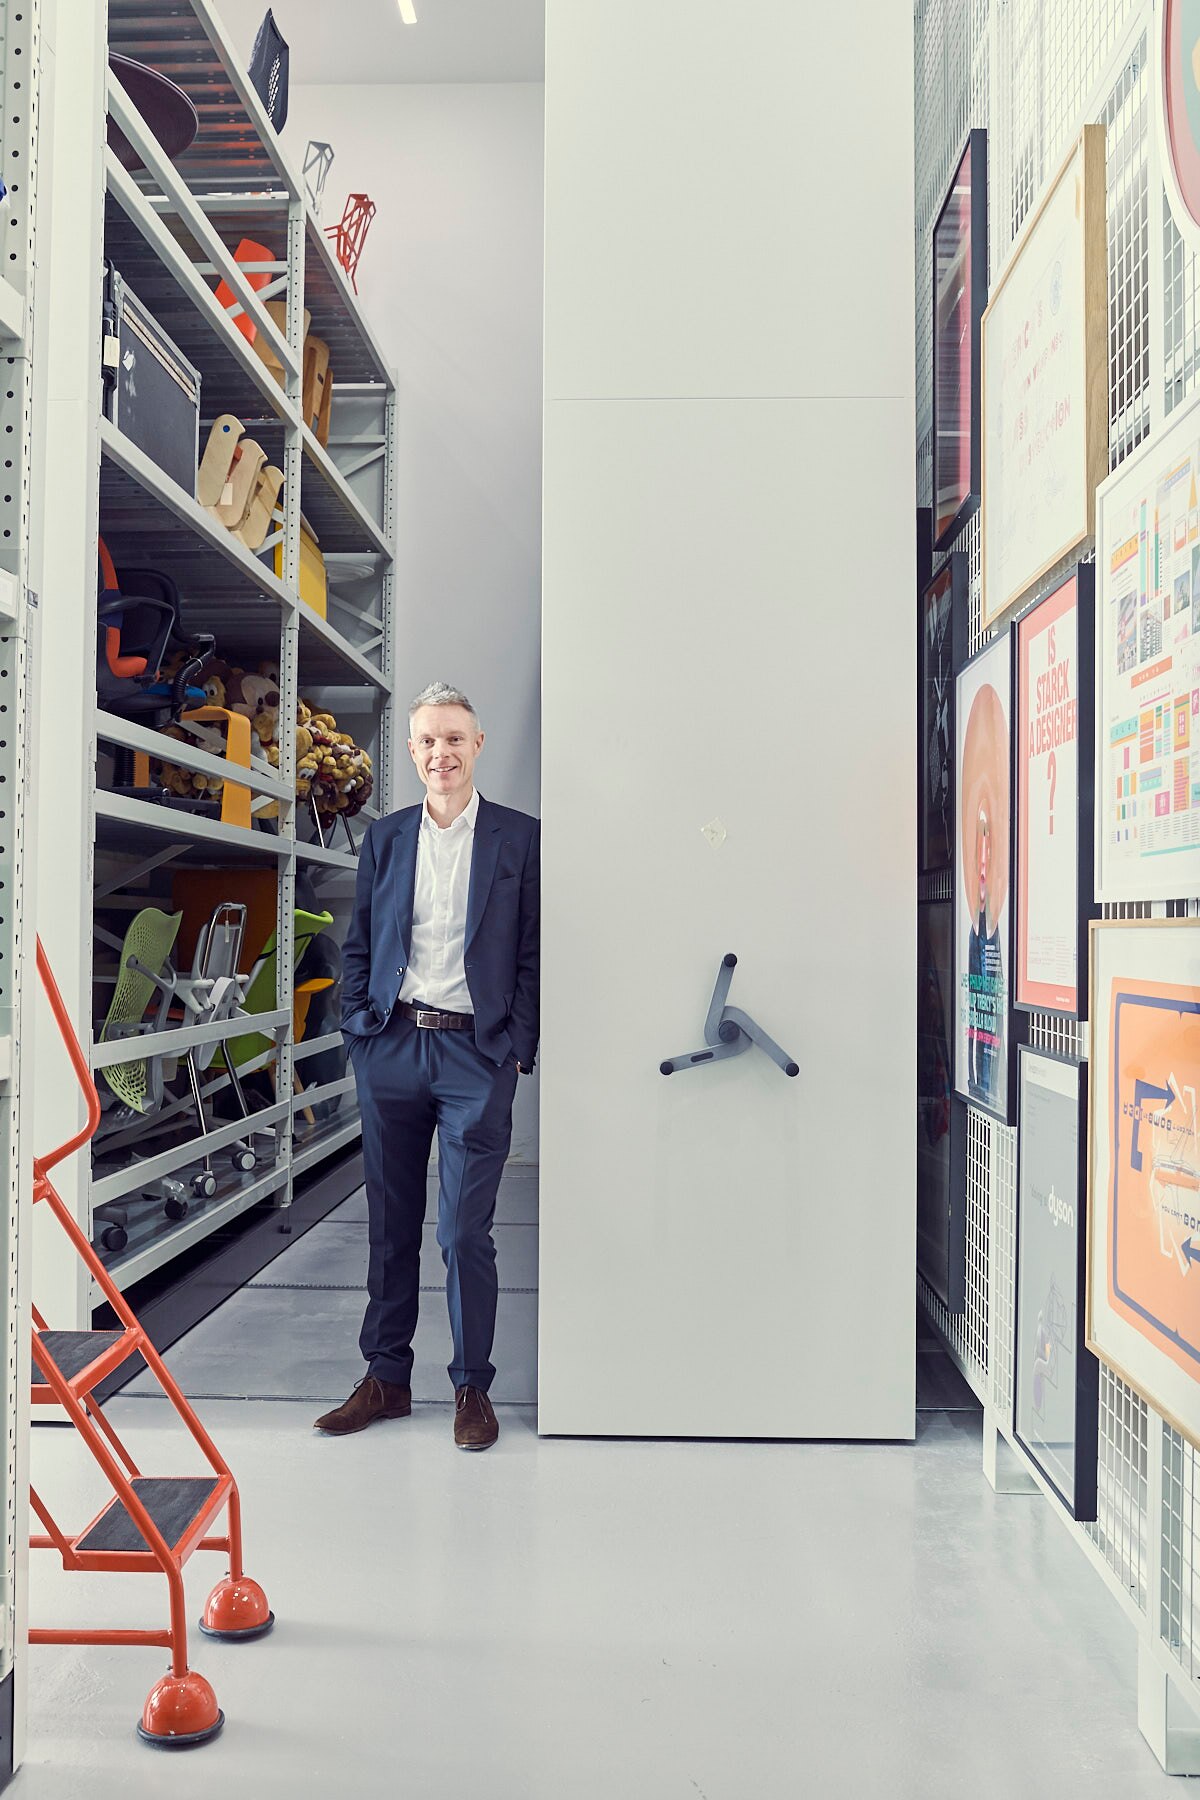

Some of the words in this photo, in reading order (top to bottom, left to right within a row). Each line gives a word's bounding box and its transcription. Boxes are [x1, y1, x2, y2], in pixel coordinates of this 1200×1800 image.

[1048, 624, 1056, 667] IS
[1037, 657, 1069, 714] STARCK
[1030, 721, 1035, 758] A
[1047, 751, 1057, 835] ?
[1123, 1101, 1143, 1121] IDEA
[1049, 1184, 1074, 1228] dyson
